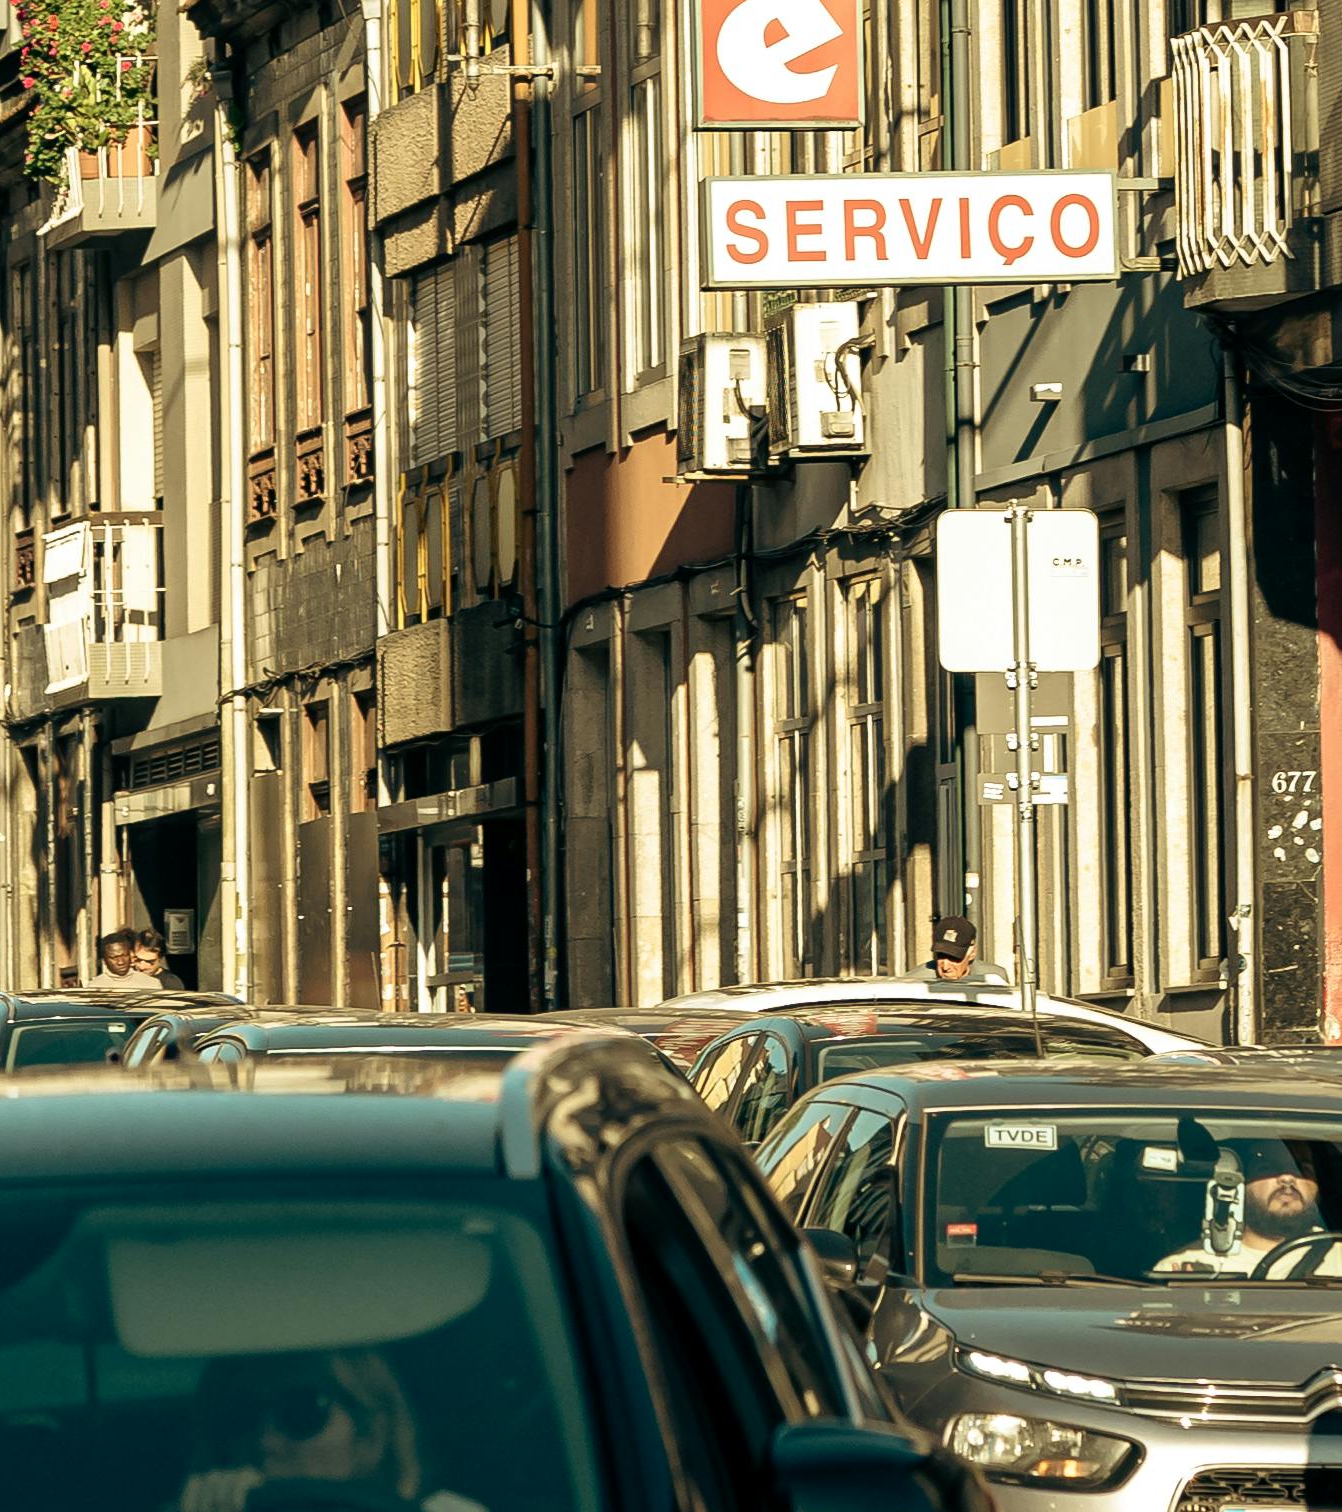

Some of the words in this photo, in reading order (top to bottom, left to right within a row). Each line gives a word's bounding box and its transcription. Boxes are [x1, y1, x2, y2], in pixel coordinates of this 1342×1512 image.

[725, 193, 1102, 266] SERVIÇO
[1271, 770, 1317, 794] 677
[994, 1129, 1048, 1143] TVDE
